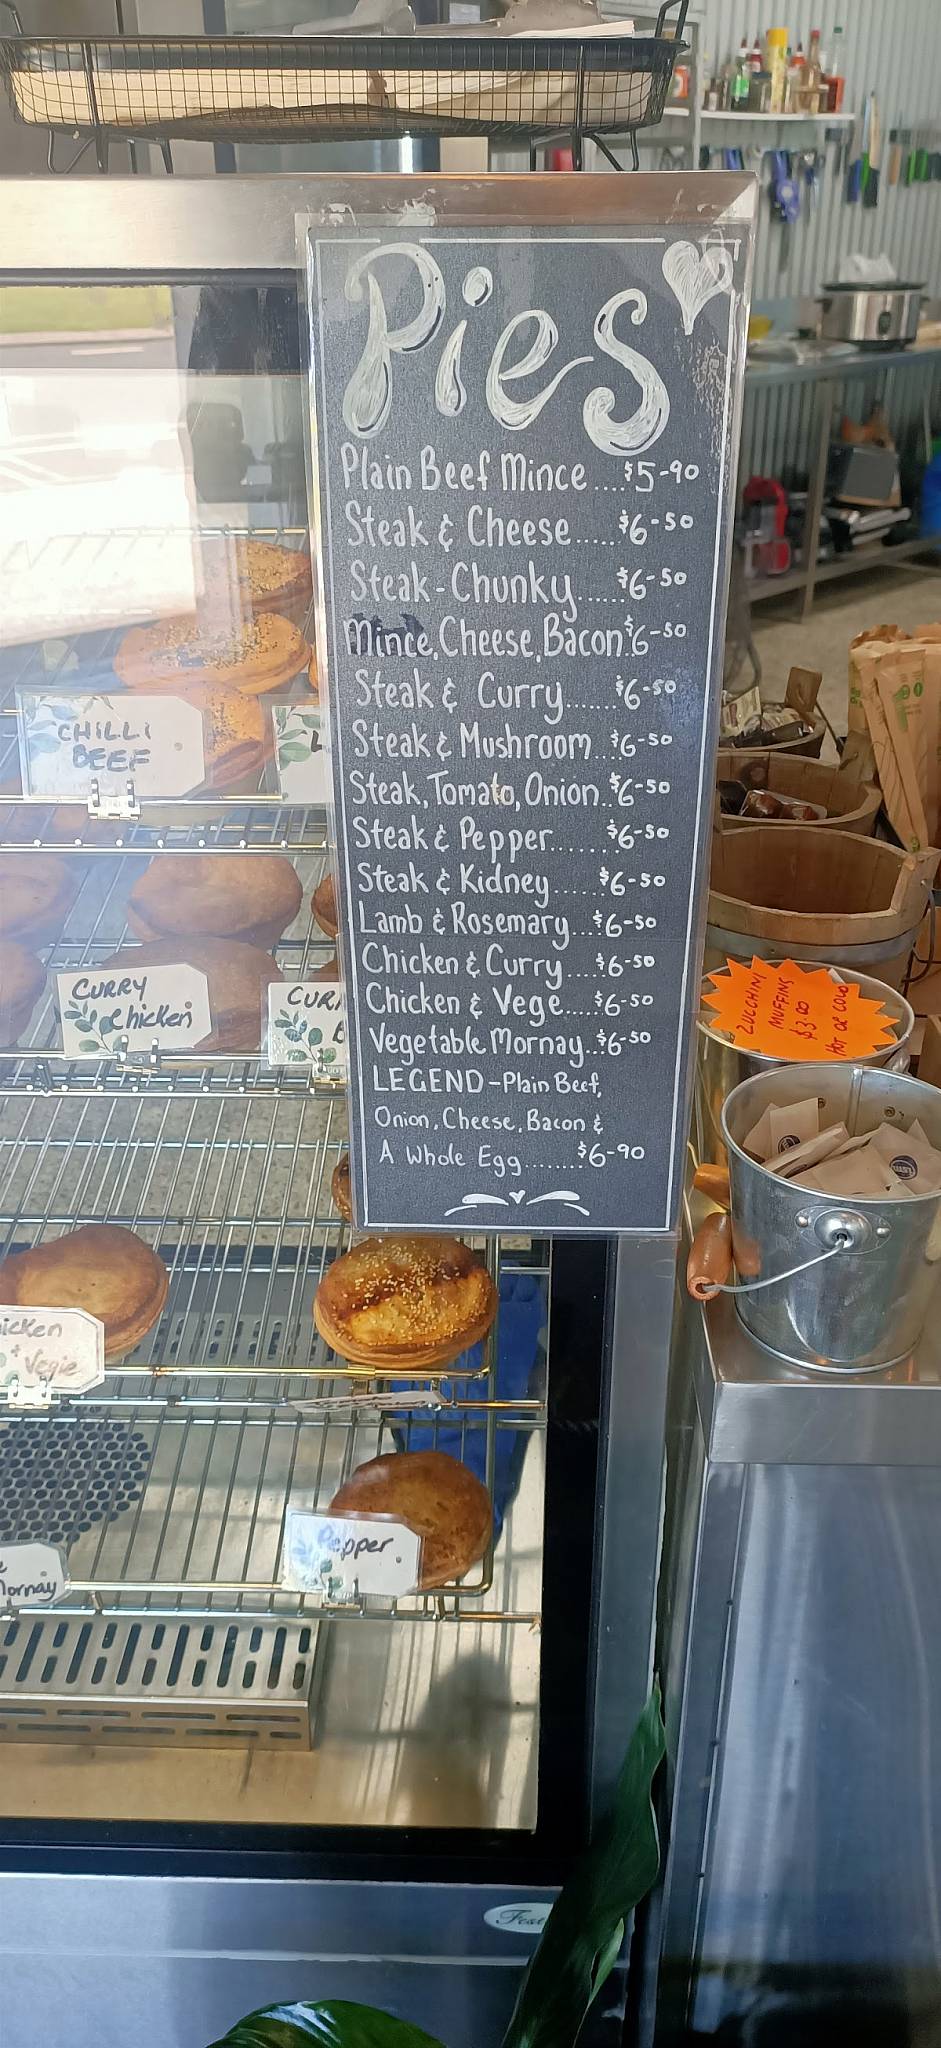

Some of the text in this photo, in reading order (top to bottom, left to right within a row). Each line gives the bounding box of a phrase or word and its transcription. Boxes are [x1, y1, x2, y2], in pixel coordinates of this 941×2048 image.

[342, 242, 670, 457] Pies
[340, 441, 700, 492] Plain Beef Mince $5-90
[345, 500, 694, 552] Steak & Cheese $6-50
[617, 566, 687, 600] $6-50
[355, 668, 678, 725] Steak & Curry $6-50
[73, 743, 151, 773] BEEF
[352, 719, 431, 758] Steak
[436, 731, 452, 761] &
[460, 722, 592, 760] Mushroom
[611, 729, 673, 758] $6-50
[525, 771, 600, 807] Onion
[609, 772, 671, 807] $6-50
[352, 814, 670, 863] Steak & Pepper $6-50
[357, 861, 666, 908] Steak & Kidney $6-50
[358, 900, 657, 951] Lamb & Rosemary $6-50
[361, 942, 655, 990] Chicken & Curry $6-50
[365, 982, 654, 1027] Chicken & Vege $6-50
[736, 972, 767, 1035] ZUCCHINI
[768, 976, 795, 1030] MUFFINS
[832, 985, 850, 1013] COLD
[369, 1017, 486, 1065] Vegetable
[490, 1027, 585, 1068] Mornay
[596, 1028, 651, 1056] $6-50
[824, 1035, 848, 1057] HOT
[373, 1066, 484, 1093] LEGEND
[554, 1071, 602, 1098] Beef,
[374, 1106, 604, 1135] Onion, Cheese, Bacon &
[379, 1140, 645, 1178] A Whole Egg $6-90
[0, 1317, 63, 1338] icken
[24, 1348, 81, 1382] Vegie
[318, 1523, 394, 1561] Pepper
